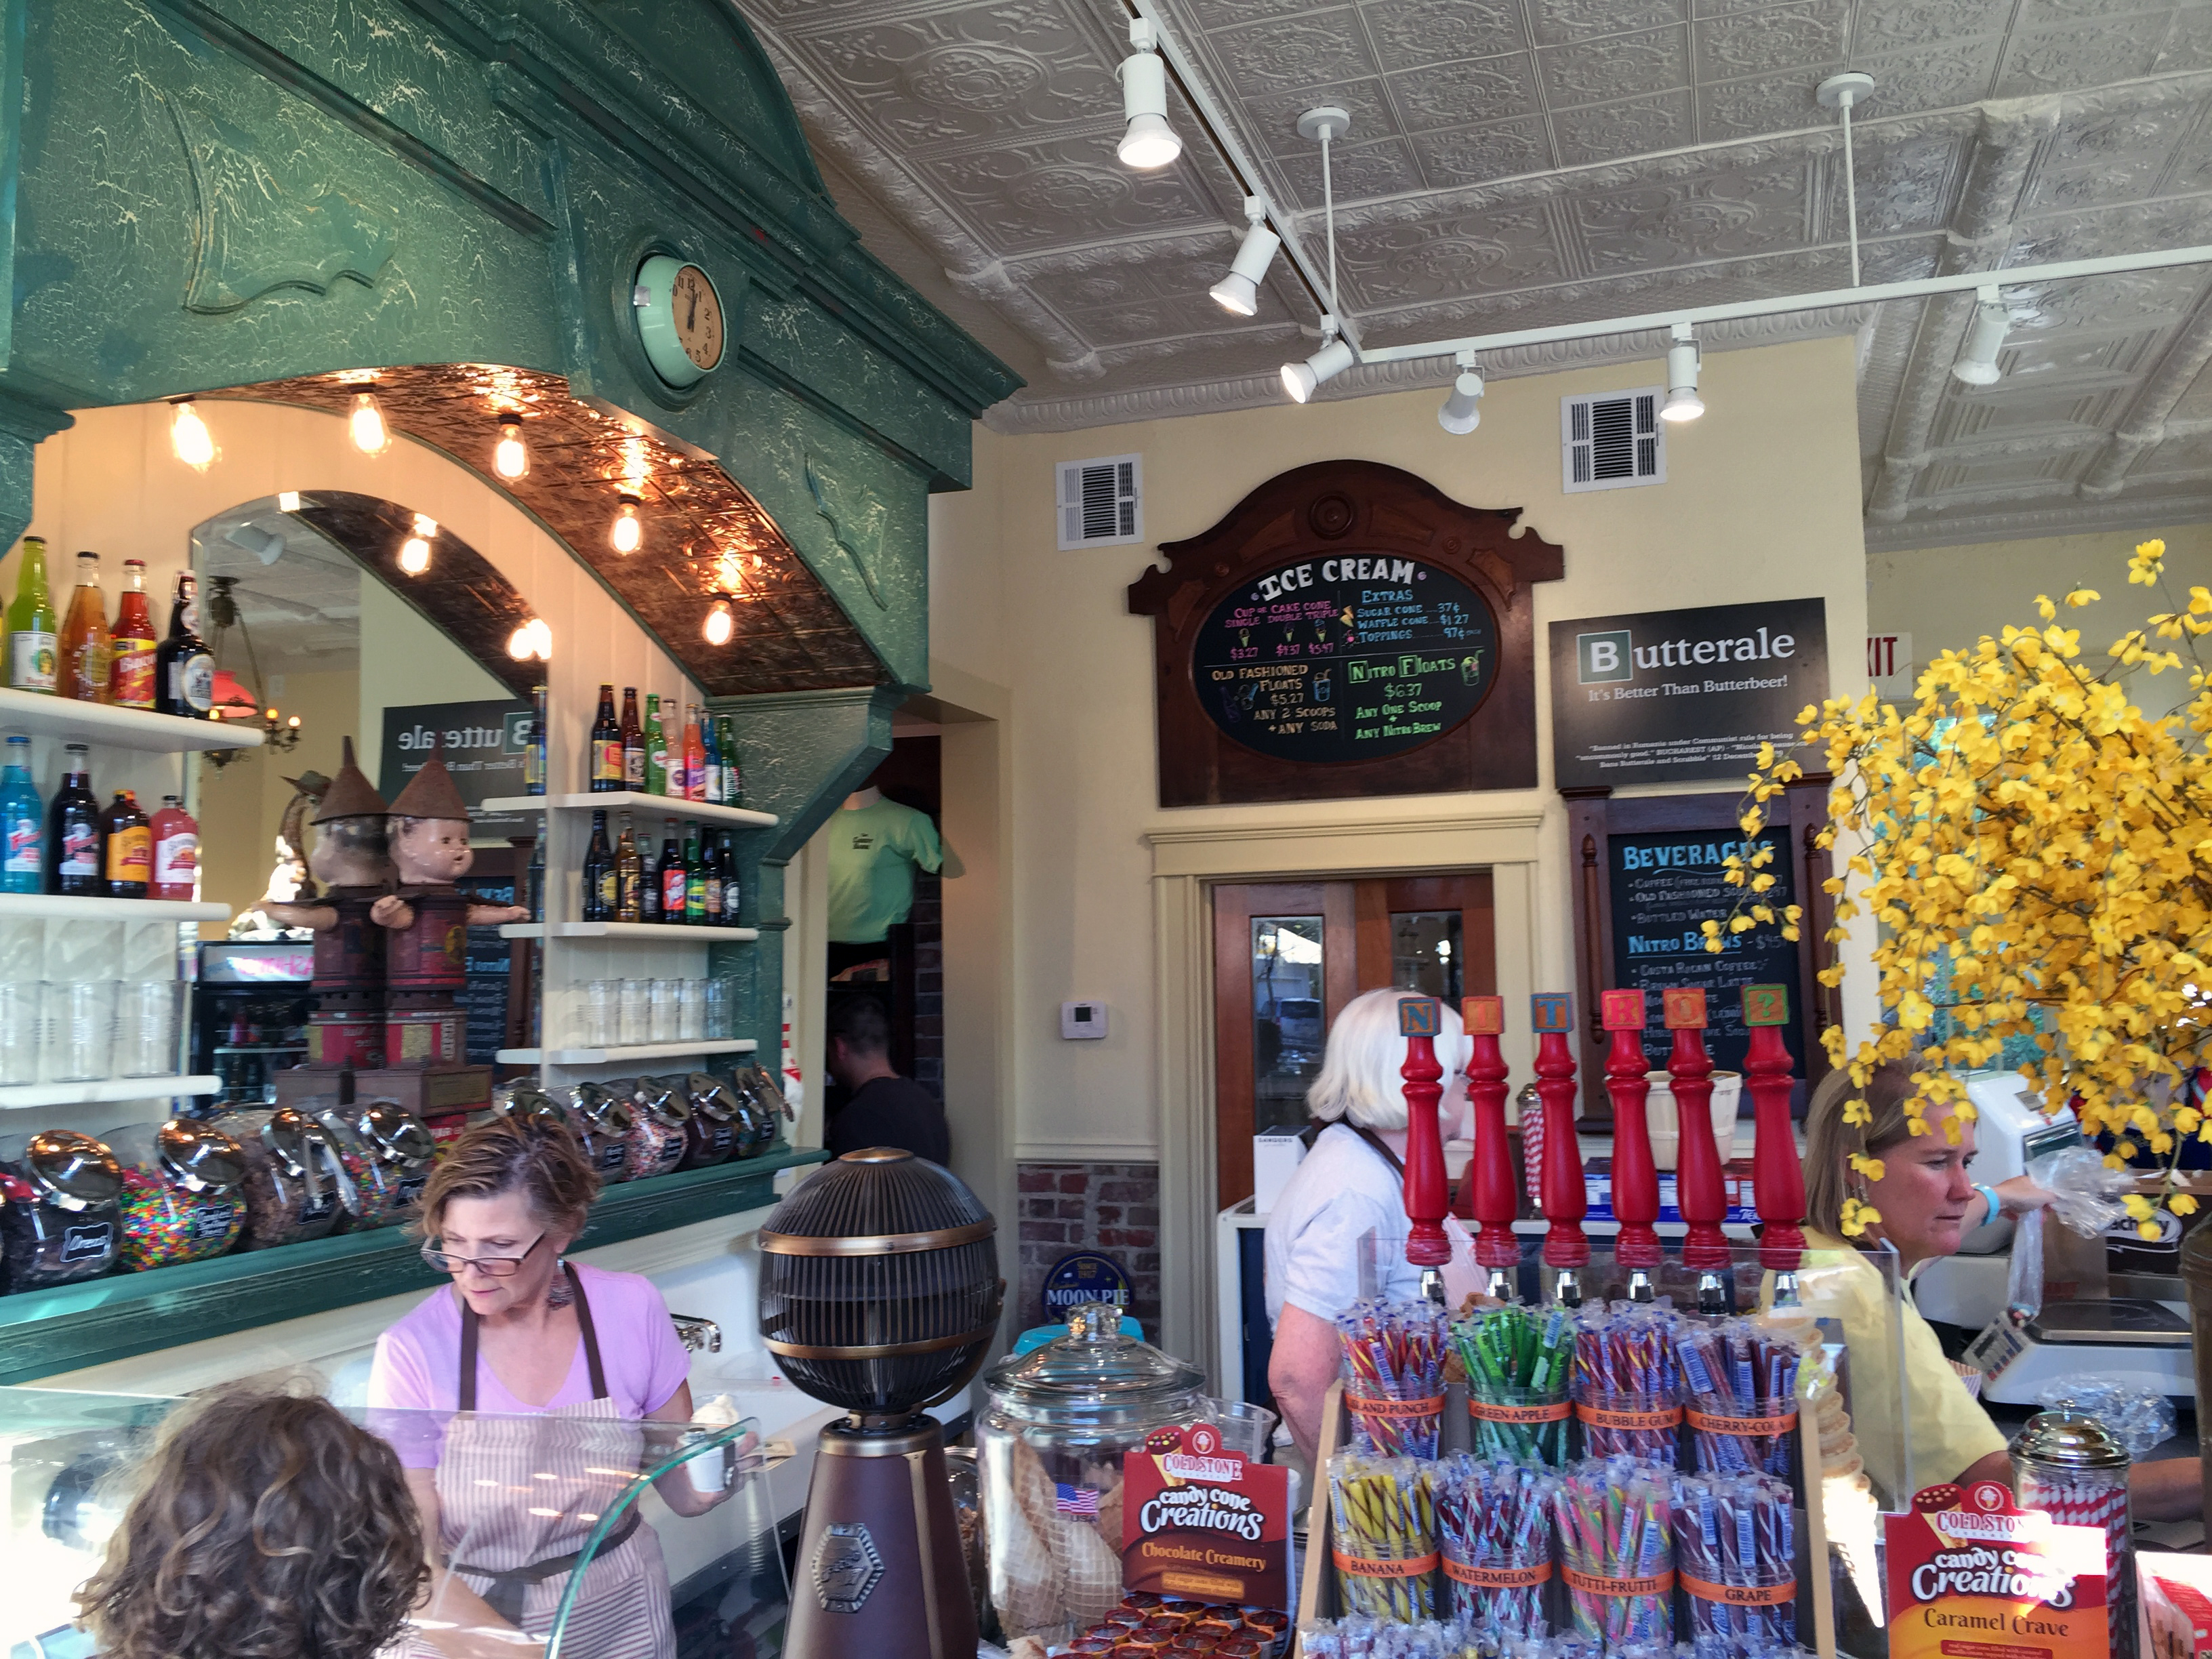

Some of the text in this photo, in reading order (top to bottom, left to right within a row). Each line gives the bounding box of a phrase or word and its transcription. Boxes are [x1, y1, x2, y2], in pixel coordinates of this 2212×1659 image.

[1257, 558, 1416, 602] ICE CREAM
[1361, 589, 1414, 604] EXTRAS
[1233, 607, 1255, 618] CUP
[1271, 602, 1300, 614] CAKE
[1303, 600, 1332, 610] CONE
[1357, 607, 1392, 618] SUGAR
[1395, 605, 1423, 615] CONE
[1225, 609, 1338, 628] SINGLE DOUBLE TRIPLE
[1357, 617, 1399, 630] WAFFLE
[1401, 615, 1429, 626] CONE
[1357, 629, 1413, 643] TOPPINGS
[1590, 626, 1796, 674] Butterale
[1868, 636, 1898, 677] XIT
[1212, 664, 1309, 681] OLD FASHIONED
[1259, 678, 1303, 692] FLOATS
[1589, 674, 1788, 702] It's Better Than Butterbeer!
[1253, 707, 1336, 720] ANY 2 SCOOPS
[1355, 700, 1442, 719] ANY ONE SCOOP
[1310, 720, 1338, 732] SODA
[1355, 727, 1380, 739] ANY
[1723, 752, 1757, 760] Decembe
[1627, 935, 1680, 954] NITRO
[1683, 931, 1742, 951] BRWS
[1389, 1402, 1429, 1416] PUNCH
[1475, 1405, 1550, 1421] GREEN APPLE
[1596, 1412, 1676, 1427] BUBBLE GUM
[1160, 1485, 1252, 1511] candy cone
[1141, 1499, 1265, 1540] Creations
[1141, 1542, 1267, 1572] Chocolate Creamery
[1935, 1547, 2000, 1570] candy
[1351, 1560, 1405, 1574] BANANA
[1452, 1564, 1537, 1584] WATERMELON
[1570, 1572, 1657, 1593] TUTTI-FRUTTI
[1912, 1564, 2076, 1609] Creatios
[1724, 1589, 1771, 1602] GRAPE
[1924, 1607, 2069, 1637] Caramel Crave
